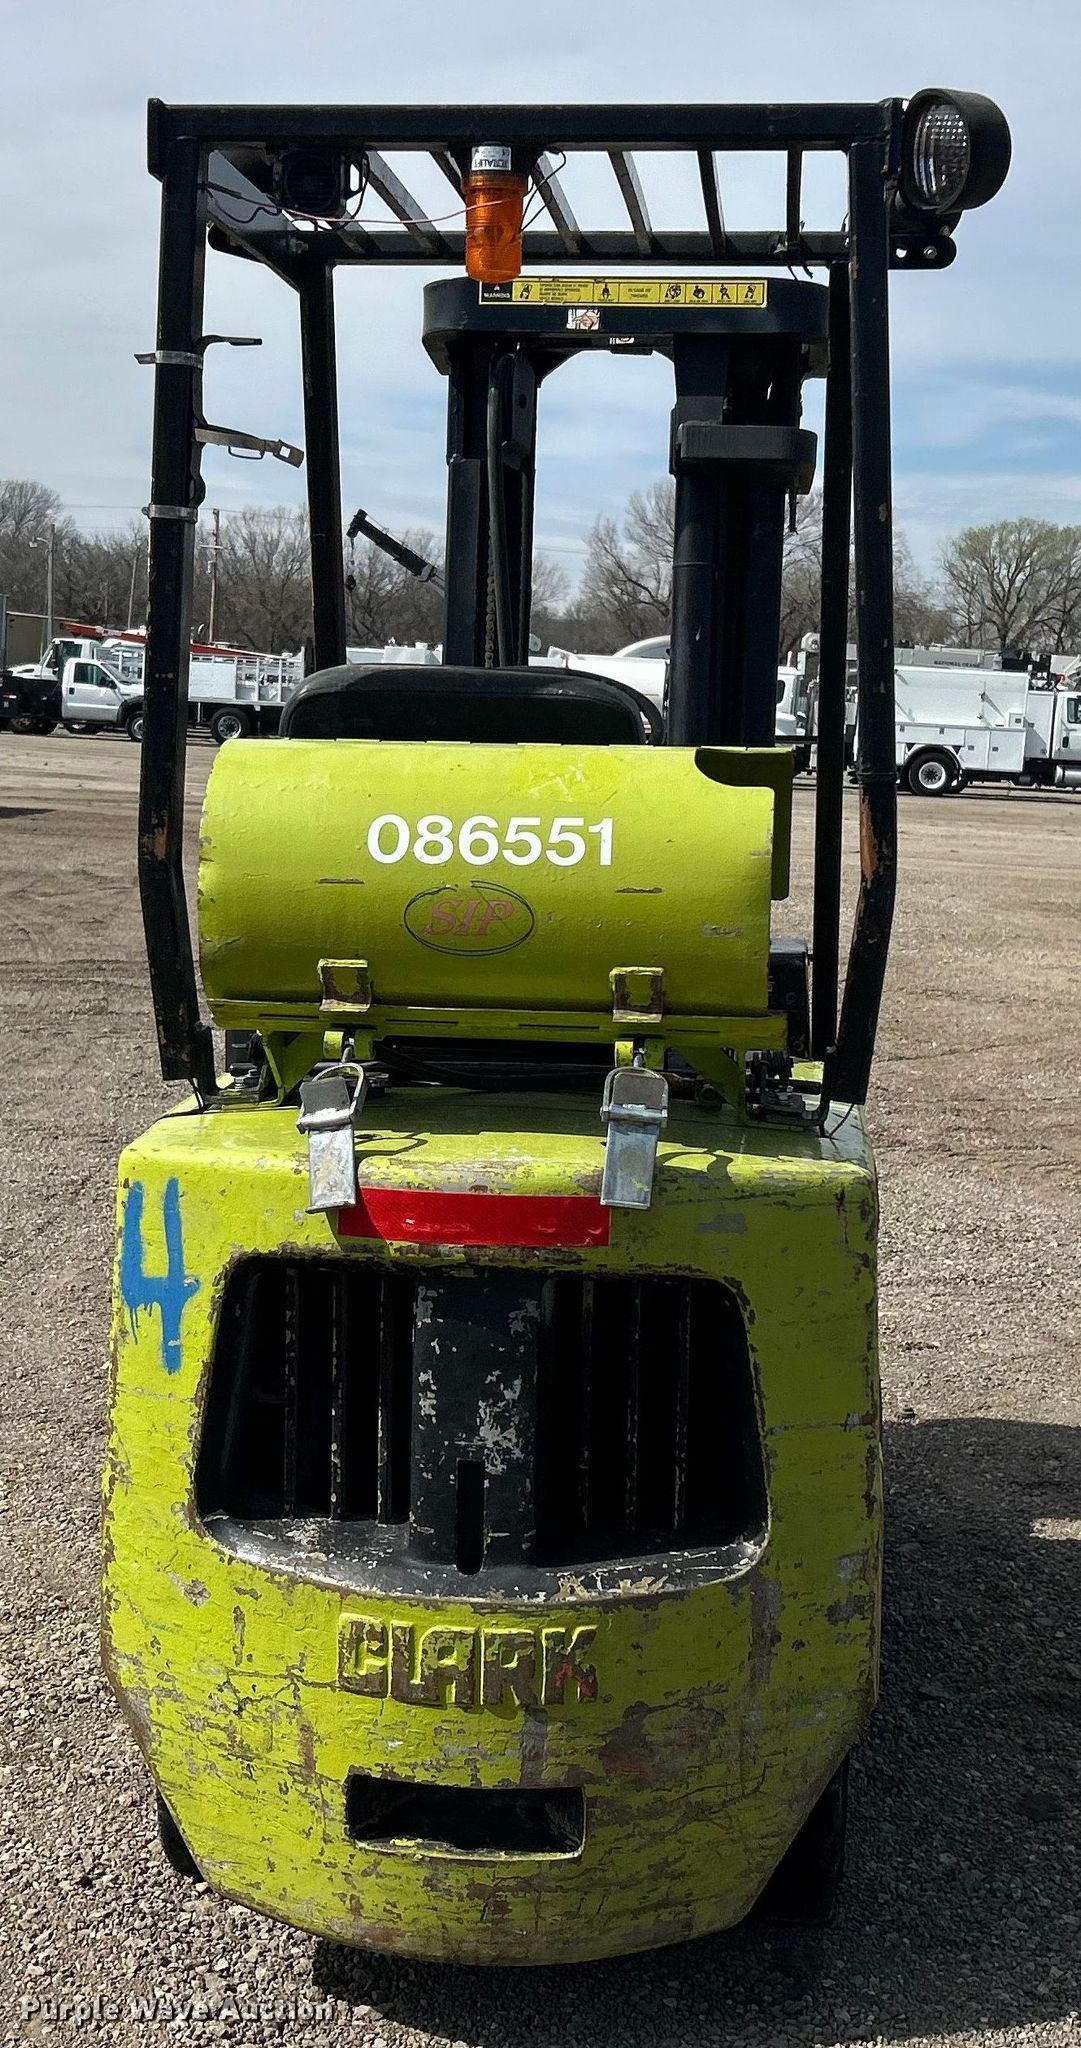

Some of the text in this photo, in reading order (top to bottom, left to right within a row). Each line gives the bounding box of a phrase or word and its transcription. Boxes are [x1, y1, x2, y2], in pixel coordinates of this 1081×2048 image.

[367, 813, 614, 866] 086551
[421, 899, 514, 937] SIP
[121, 1177, 201, 1372] 4
[336, 1612, 600, 1706] CLARK
